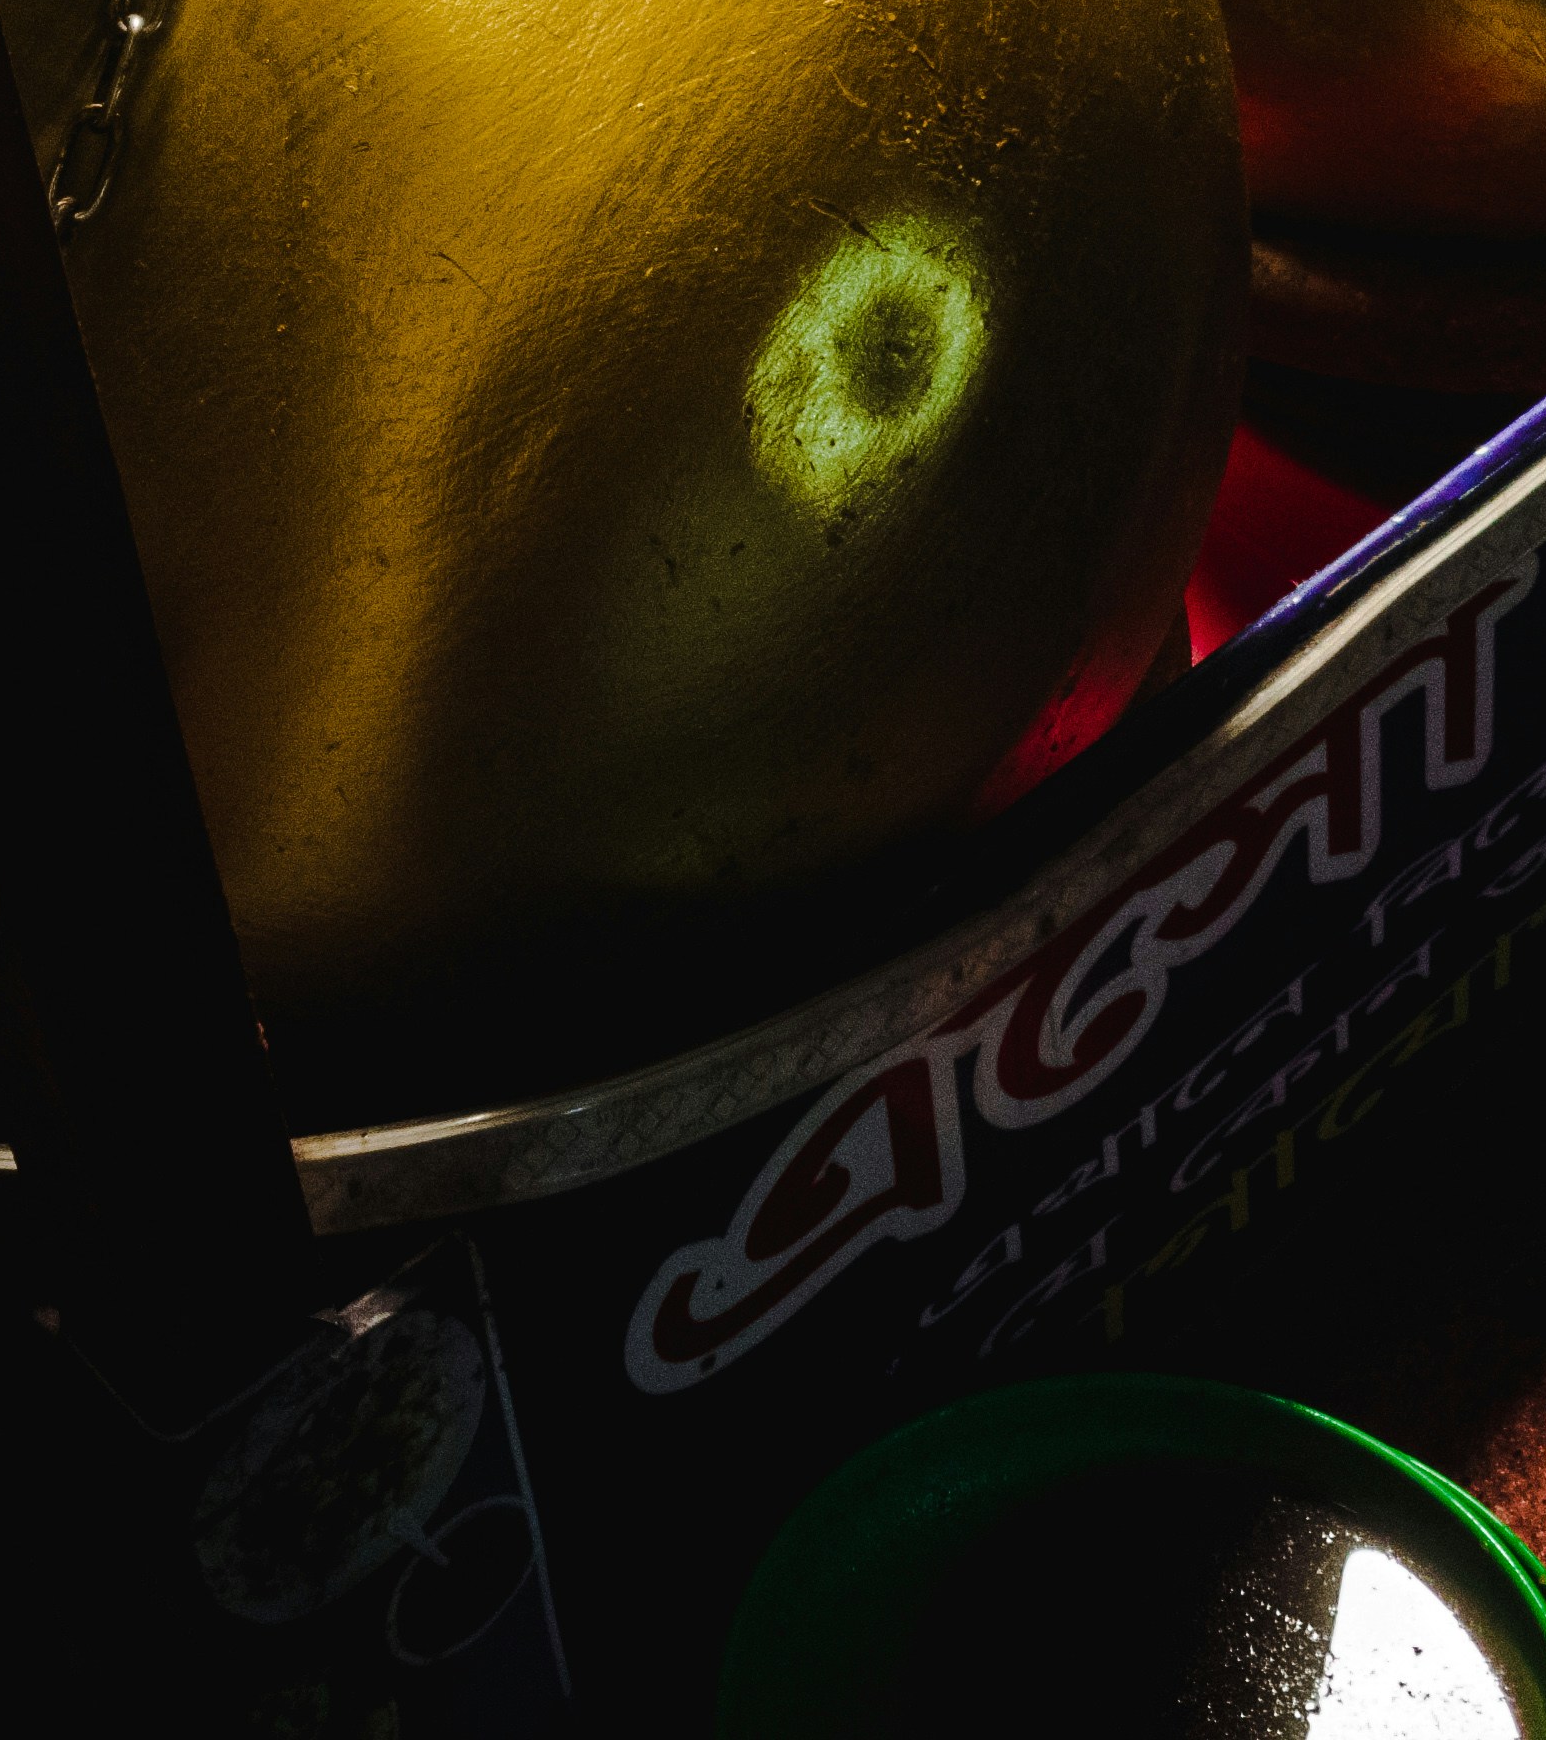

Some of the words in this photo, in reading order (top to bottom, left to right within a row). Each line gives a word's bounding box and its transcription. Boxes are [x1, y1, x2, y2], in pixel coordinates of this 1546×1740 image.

[624, 550, 1540, 1394] এসো
[919, 964, 1315, 1327] এখানে
[980, 1216, 1117, 1355] যে
[1169, 930, 1440, 1192] কোন
